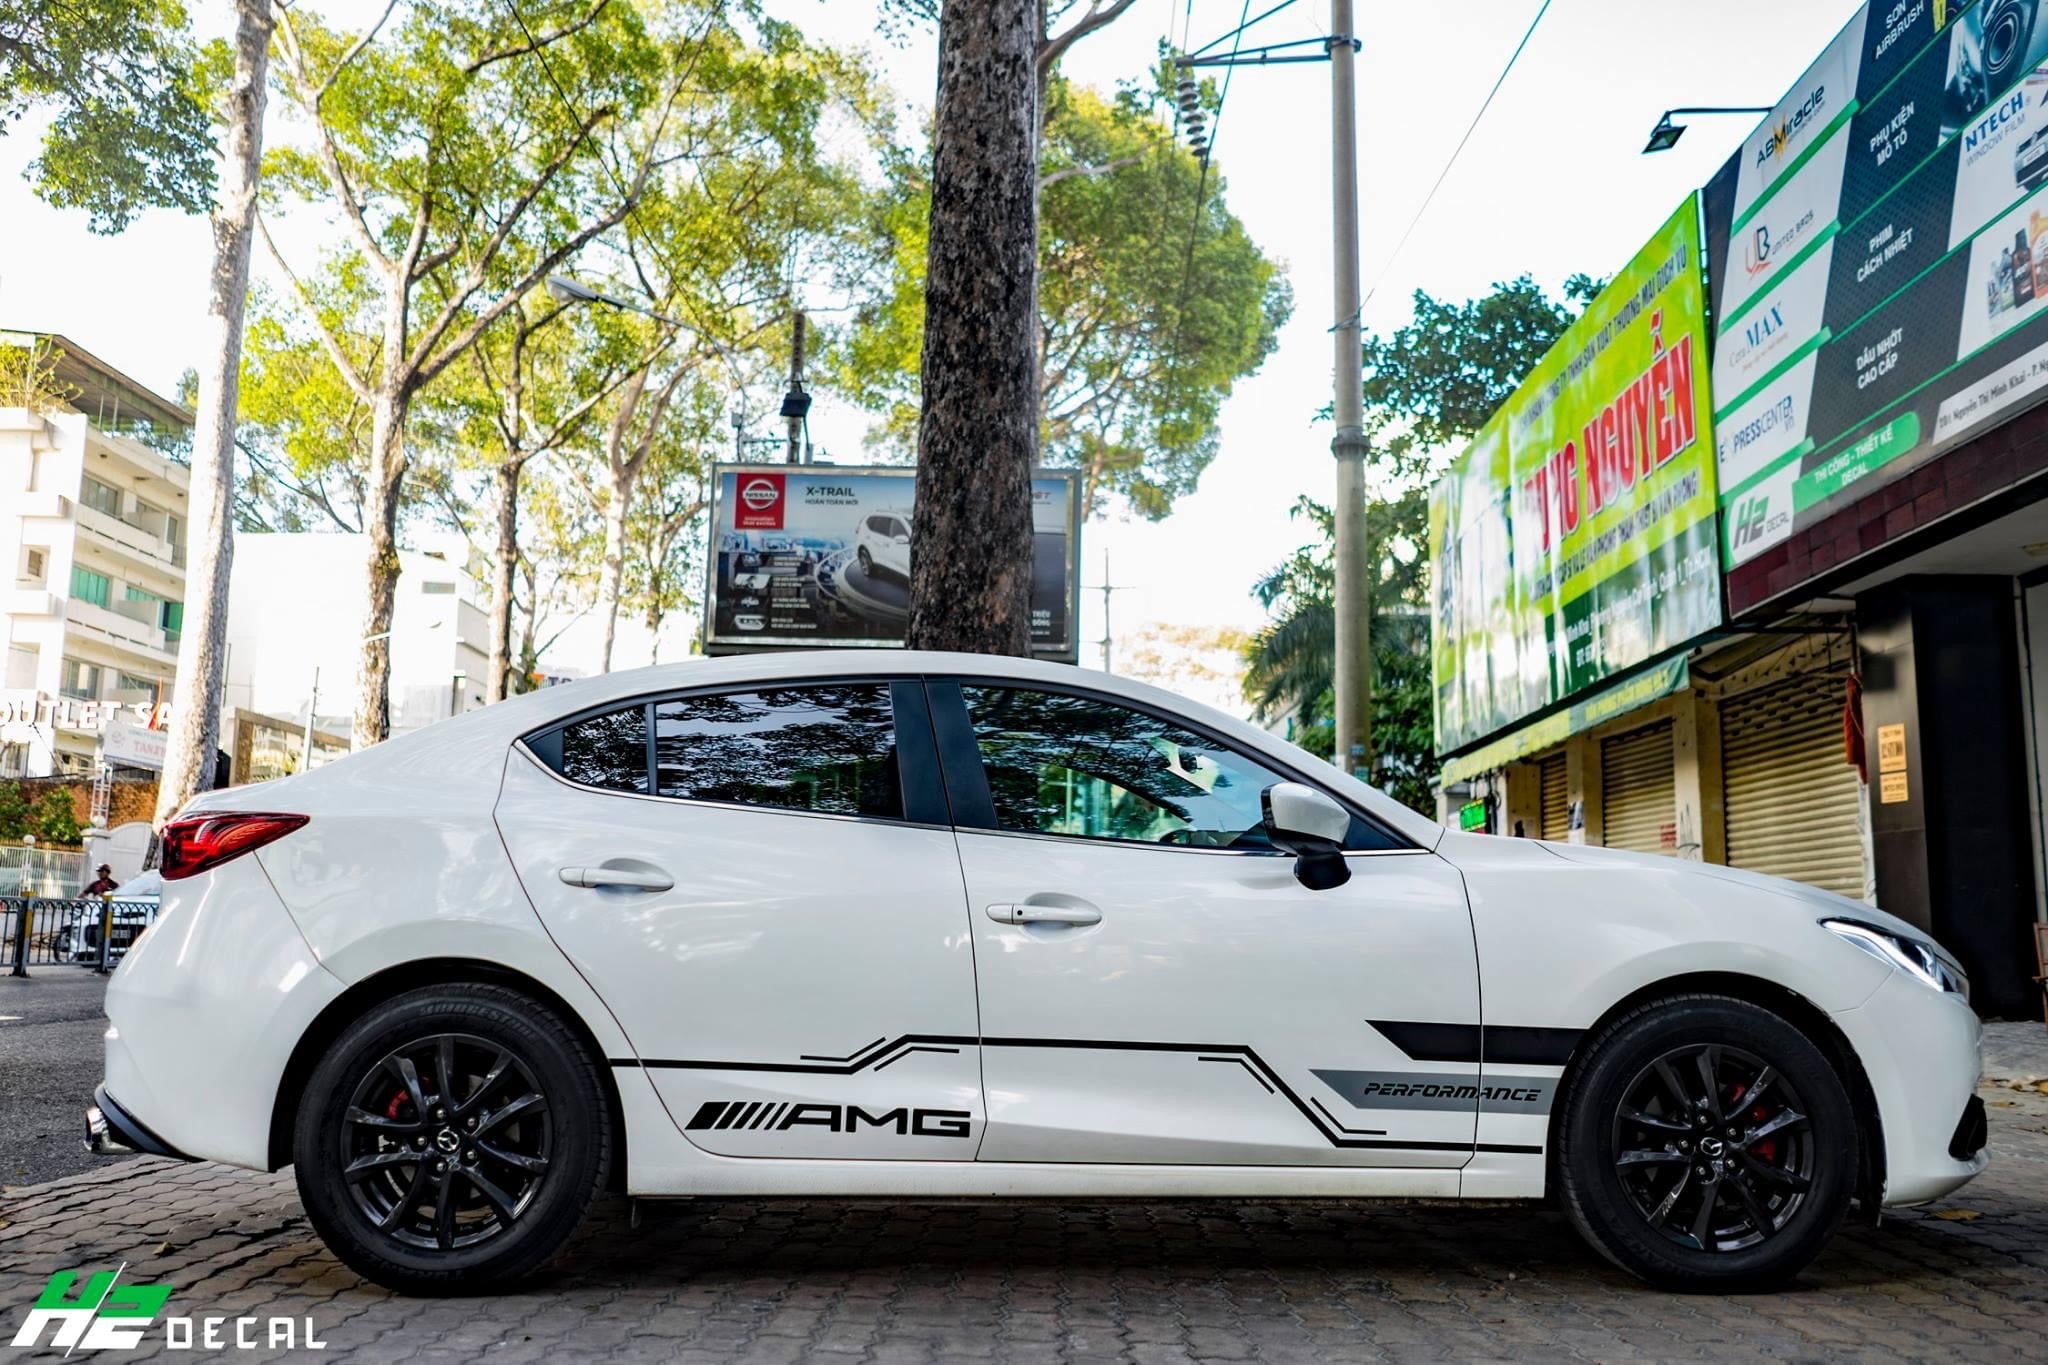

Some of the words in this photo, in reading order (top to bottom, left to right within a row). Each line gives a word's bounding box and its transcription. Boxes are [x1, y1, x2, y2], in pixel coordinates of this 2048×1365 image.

[1875, 1, 1924, 60] AIRBRUSH
[1857, 252, 1884, 282] CÁCH
[1884, 227, 1913, 262] NHIỆT
[1869, 224, 1893, 253] PHIM
[1858, 366, 1878, 389] CAO
[1879, 351, 1898, 376] CẤP
[805, 486, 855, 497] X-TRAIL
[1363, 1082, 1541, 1102] PERFORMANCE
[775, 1103, 971, 1138] AMG
